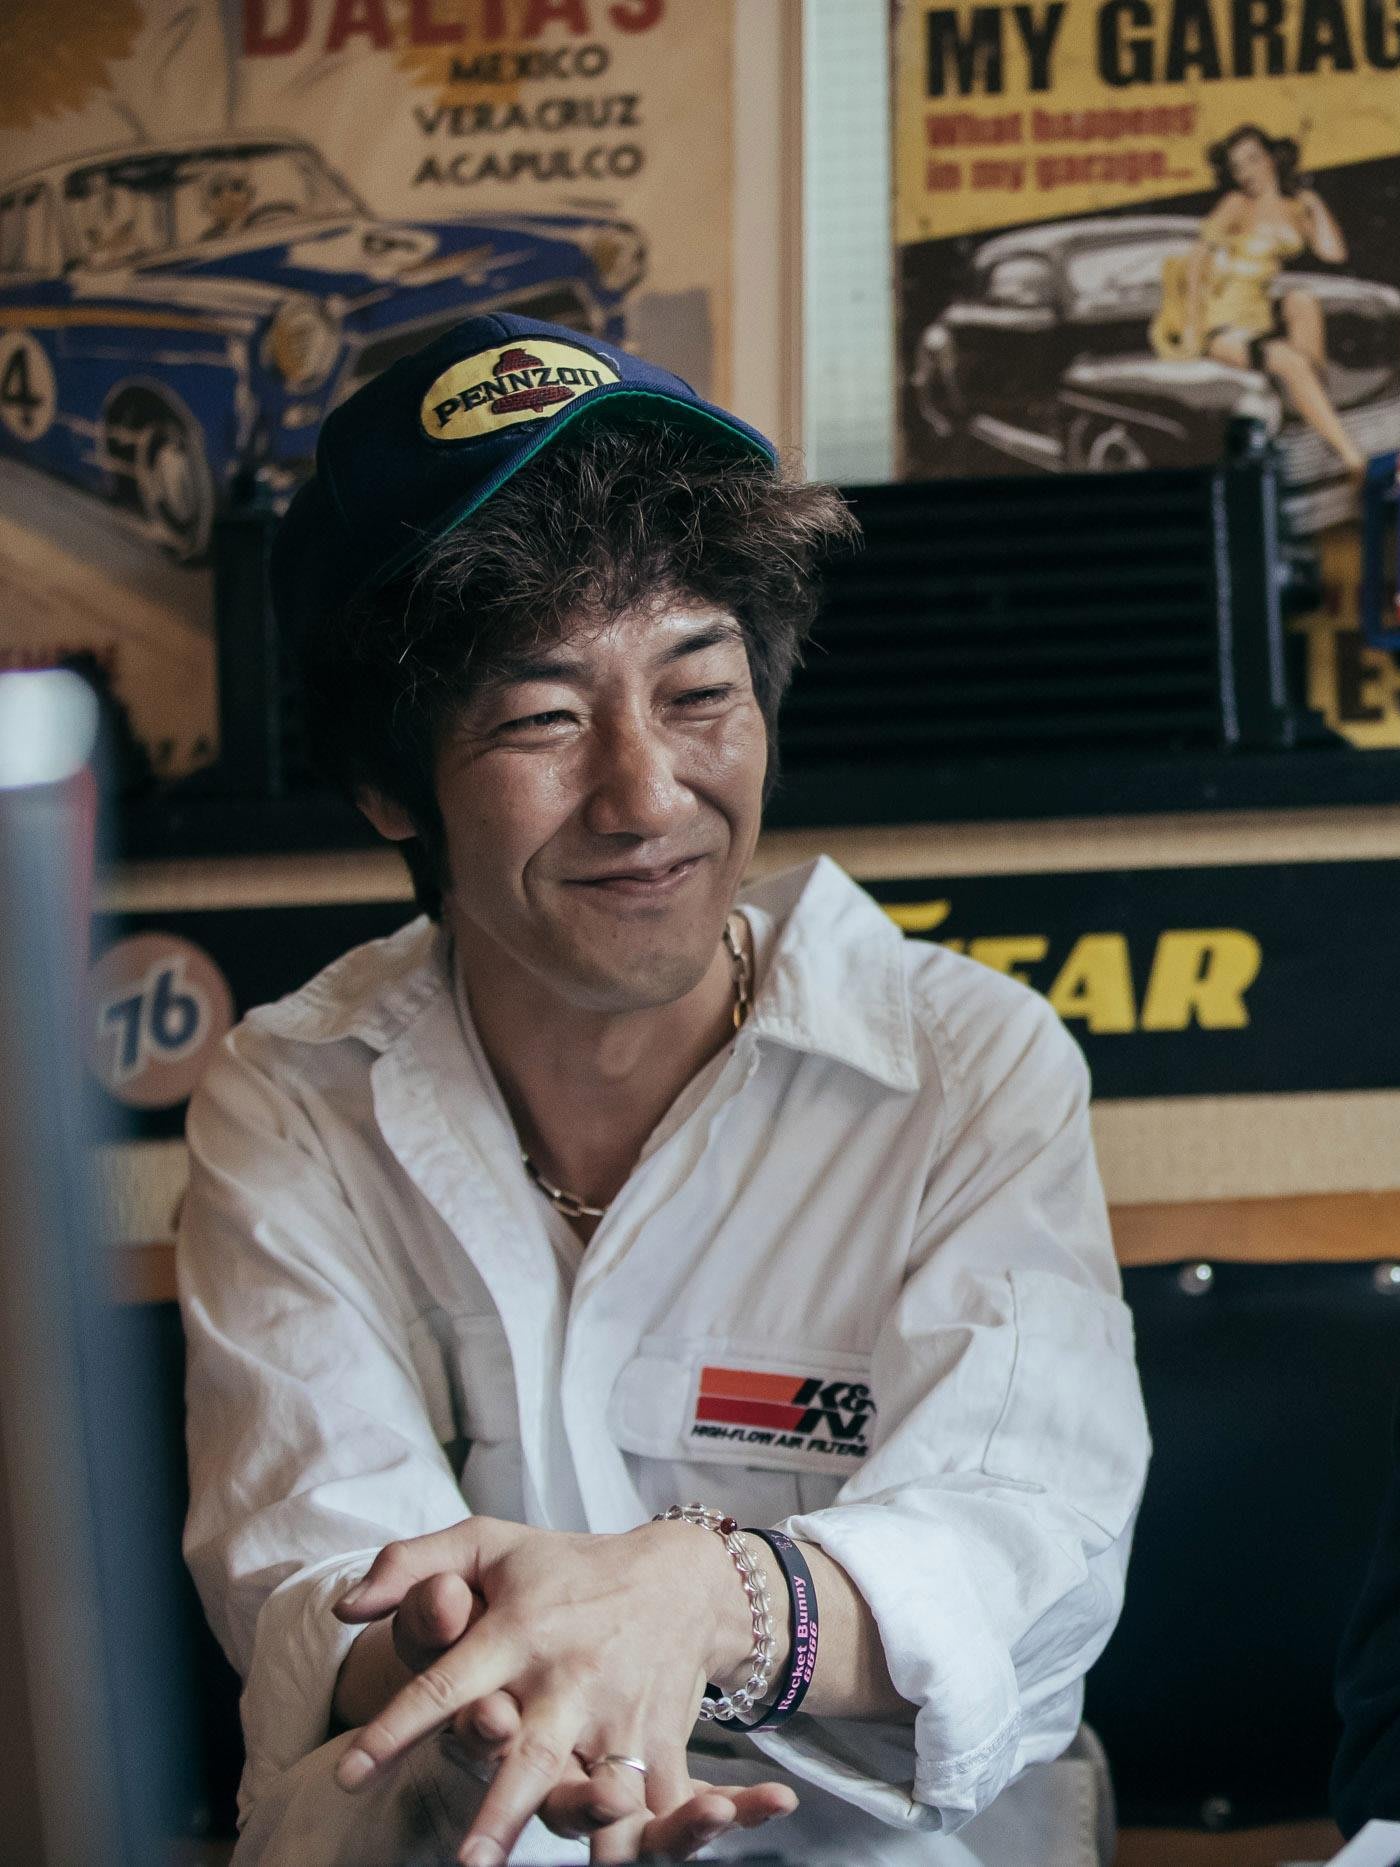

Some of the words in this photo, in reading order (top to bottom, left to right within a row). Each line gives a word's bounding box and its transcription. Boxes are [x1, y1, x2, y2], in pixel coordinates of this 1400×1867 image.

[449, 44, 612, 85] MEXICO
[927, 5, 1066, 97] MY
[414, 93, 643, 138] VERACRUZ
[925, 112, 1023, 148] What
[1031, 102, 1199, 142] happens
[413, 144, 645, 187] ACAPULCO
[926, 164, 961, 193] in
[971, 160, 1027, 193] my
[952, 928, 1263, 1036] EAR
[105, 966, 199, 1068] 76
[777, 1642, 809, 1711] Rocket
[793, 1575, 810, 1638] Bunny
